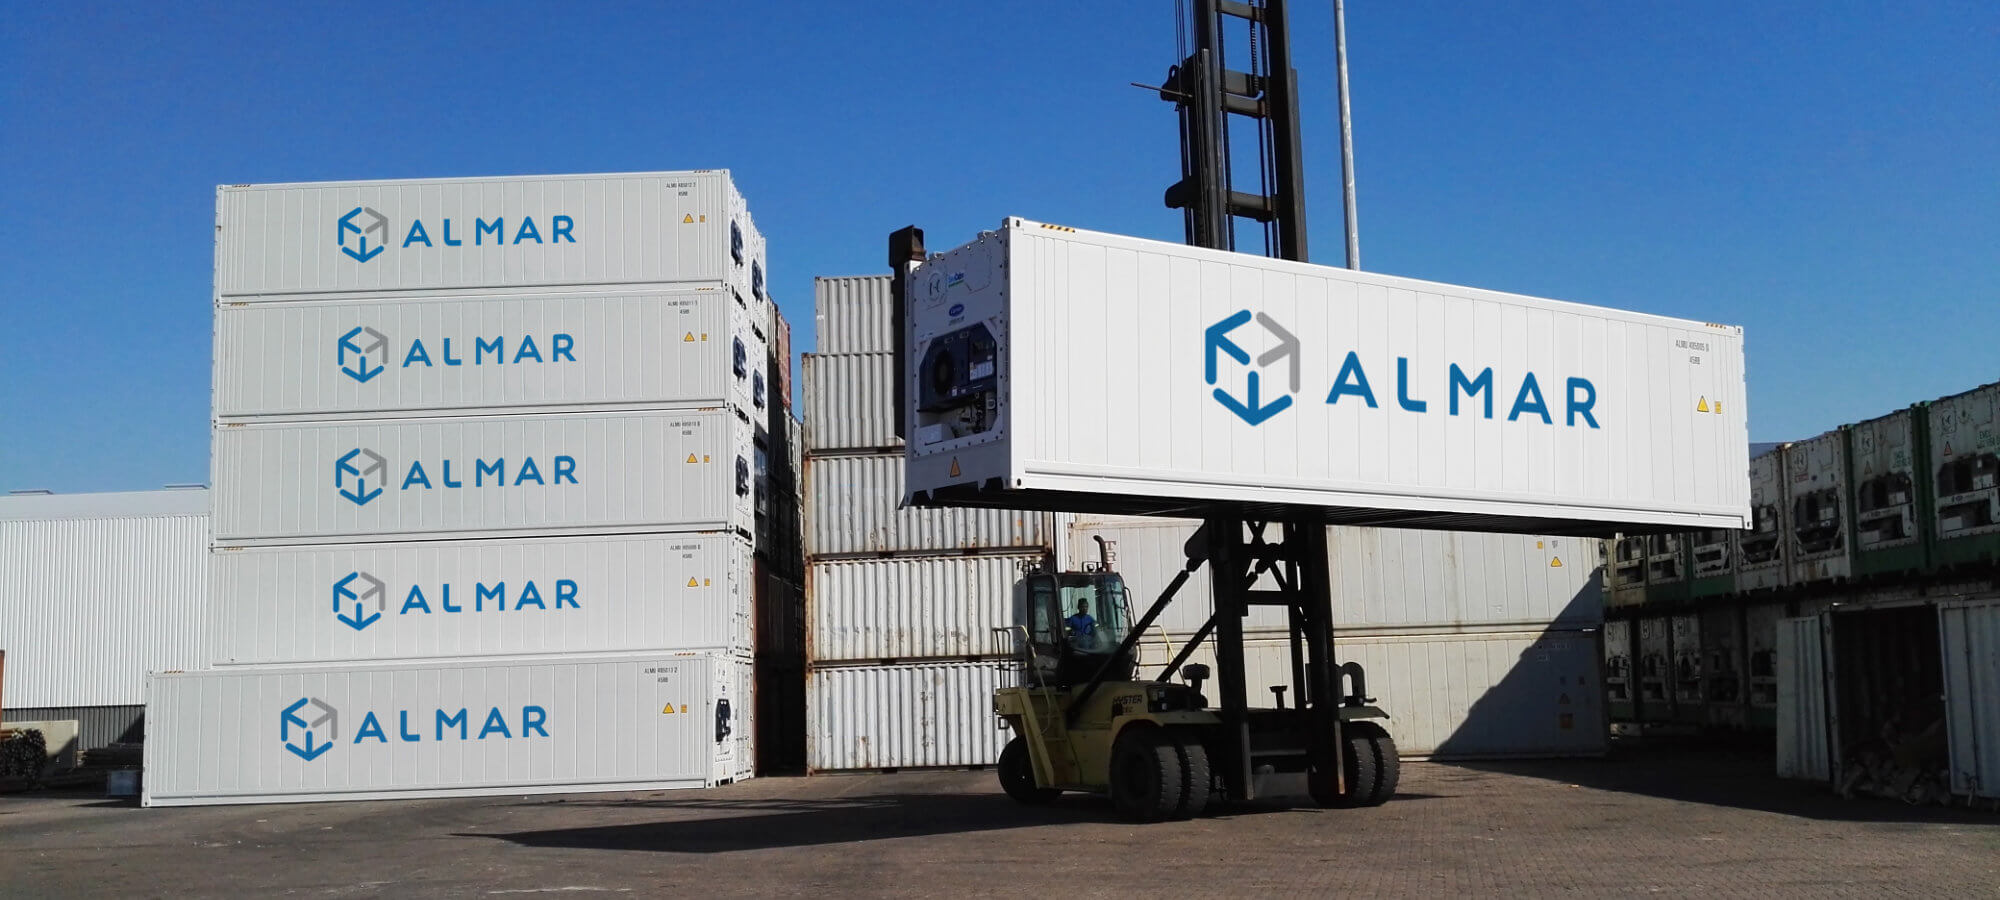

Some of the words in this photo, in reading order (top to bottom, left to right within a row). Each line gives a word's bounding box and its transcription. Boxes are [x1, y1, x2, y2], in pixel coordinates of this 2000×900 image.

[403, 215, 576, 248] ALMAR
[403, 334, 576, 367] ALMAR
[1326, 352, 1600, 428] ALMAR
[402, 456, 578, 490] ALMAR
[400, 579, 580, 614] ALMAR
[1113, 694, 1142, 704] HYSTER
[354, 706, 549, 743] ALMAR
